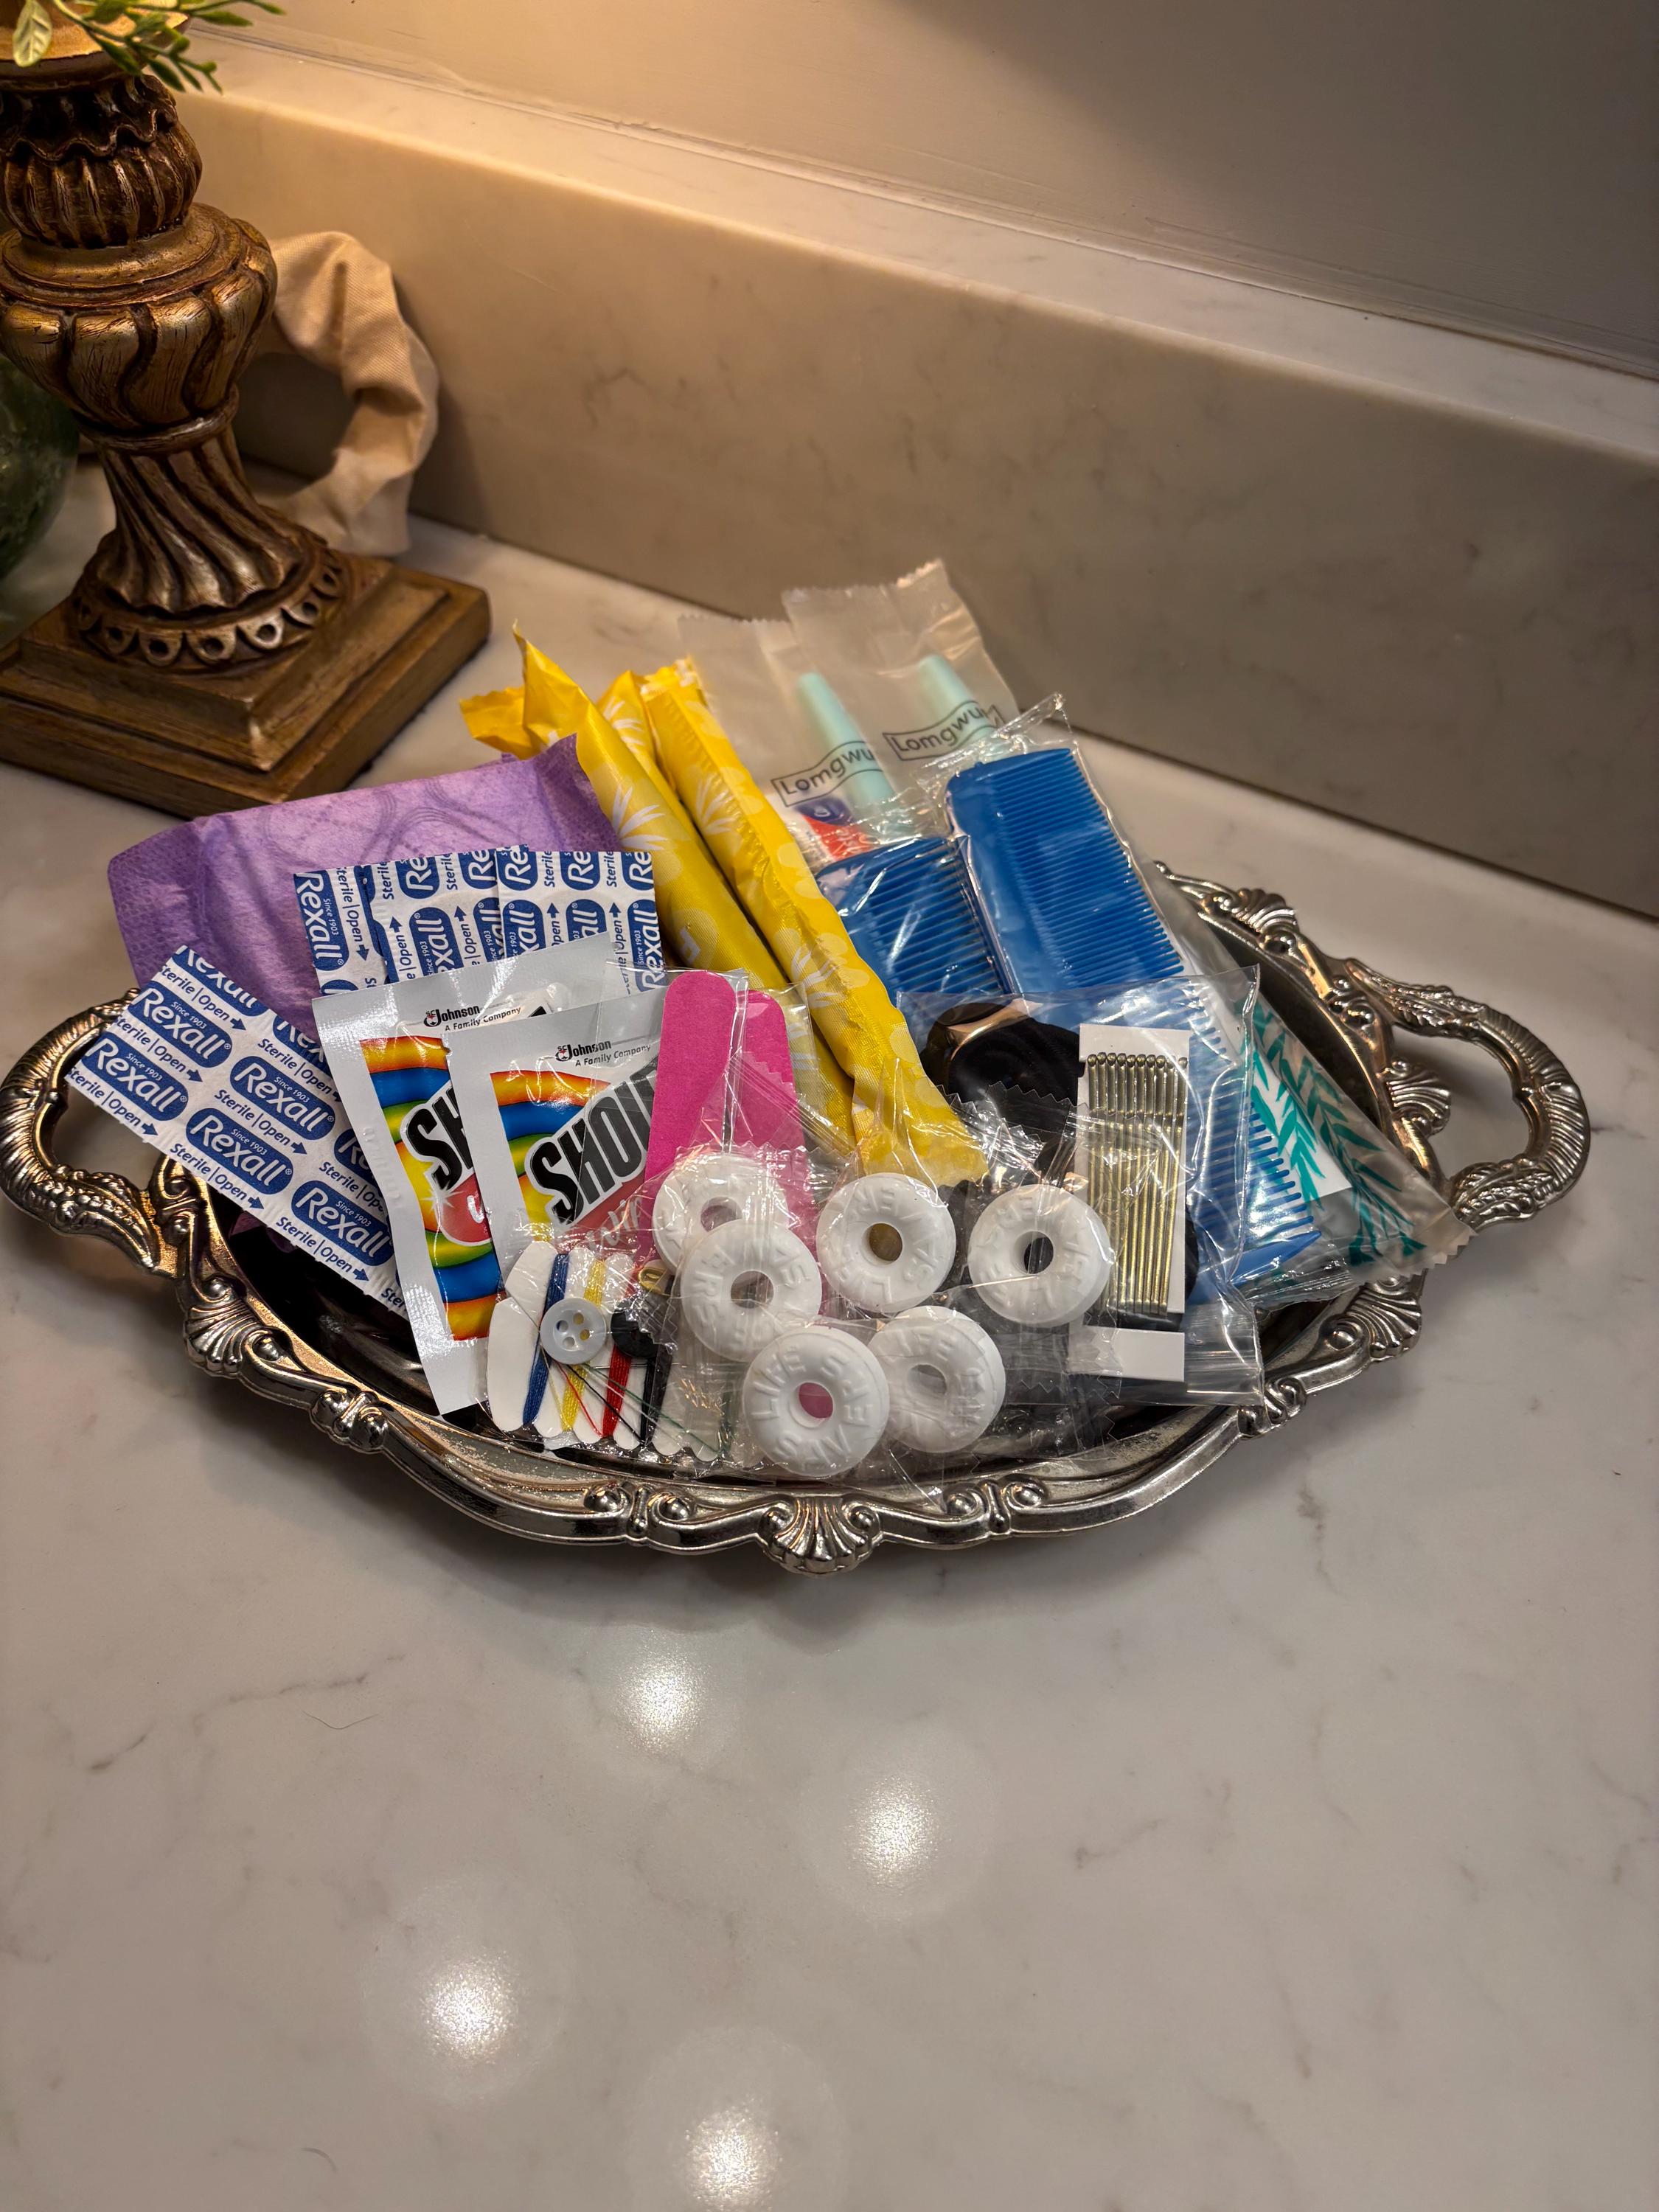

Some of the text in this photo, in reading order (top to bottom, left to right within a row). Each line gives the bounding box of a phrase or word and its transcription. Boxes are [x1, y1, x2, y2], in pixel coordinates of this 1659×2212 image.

[296, 873, 343, 960] Rexall
[323, 898, 339, 936] Since 1903
[336, 867, 363, 942] terile Open
[395, 935, 413, 966] Open
[420, 941, 431, 957] 1903
[460, 923, 477, 953] Open
[483, 931, 493, 947] 1903
[634, 930, 642, 945] 1903
[171, 1001, 208, 1029] Since 1903
[198, 995, 230, 1021] Open
[424, 1006, 480, 1027] Johnson
[453, 1018, 481, 1030] Family
[483, 1006, 521, 1023] Company
[131, 987, 225, 1060] Rexall
[154, 1046, 186, 1073] Open
[555, 1041, 612, 1062] Johnson
[584, 1054, 612, 1065] Family
[613, 1044, 652, 1059] Company
[85, 1037, 181, 1113] Rexall
[126, 1053, 163, 1082] Since 1903
[257, 1038, 297, 1069] Sterile
[301, 1068, 333, 1095] Open
[234, 1062, 328, 1132] Rexall
[274, 1077, 310, 1103] Since 1903
[108, 1099, 142, 1127] Open
[215, 1089, 291, 1146] Sterile Open
[189, 1115, 287, 1186] Rexall
[231, 1129, 268, 1155] Since 1903
[531, 1055, 658, 1225] SHOU
[170, 1143, 248, 1200] Sterile Open
[319, 1161, 383, 1212] Sterile Ope
[296, 1187, 390, 1258] Rexall
[335, 1200, 372, 1227] Since 1903
[276, 1217, 352, 1273] Sterile Open
[381, 1287, 406, 1308] Ster
